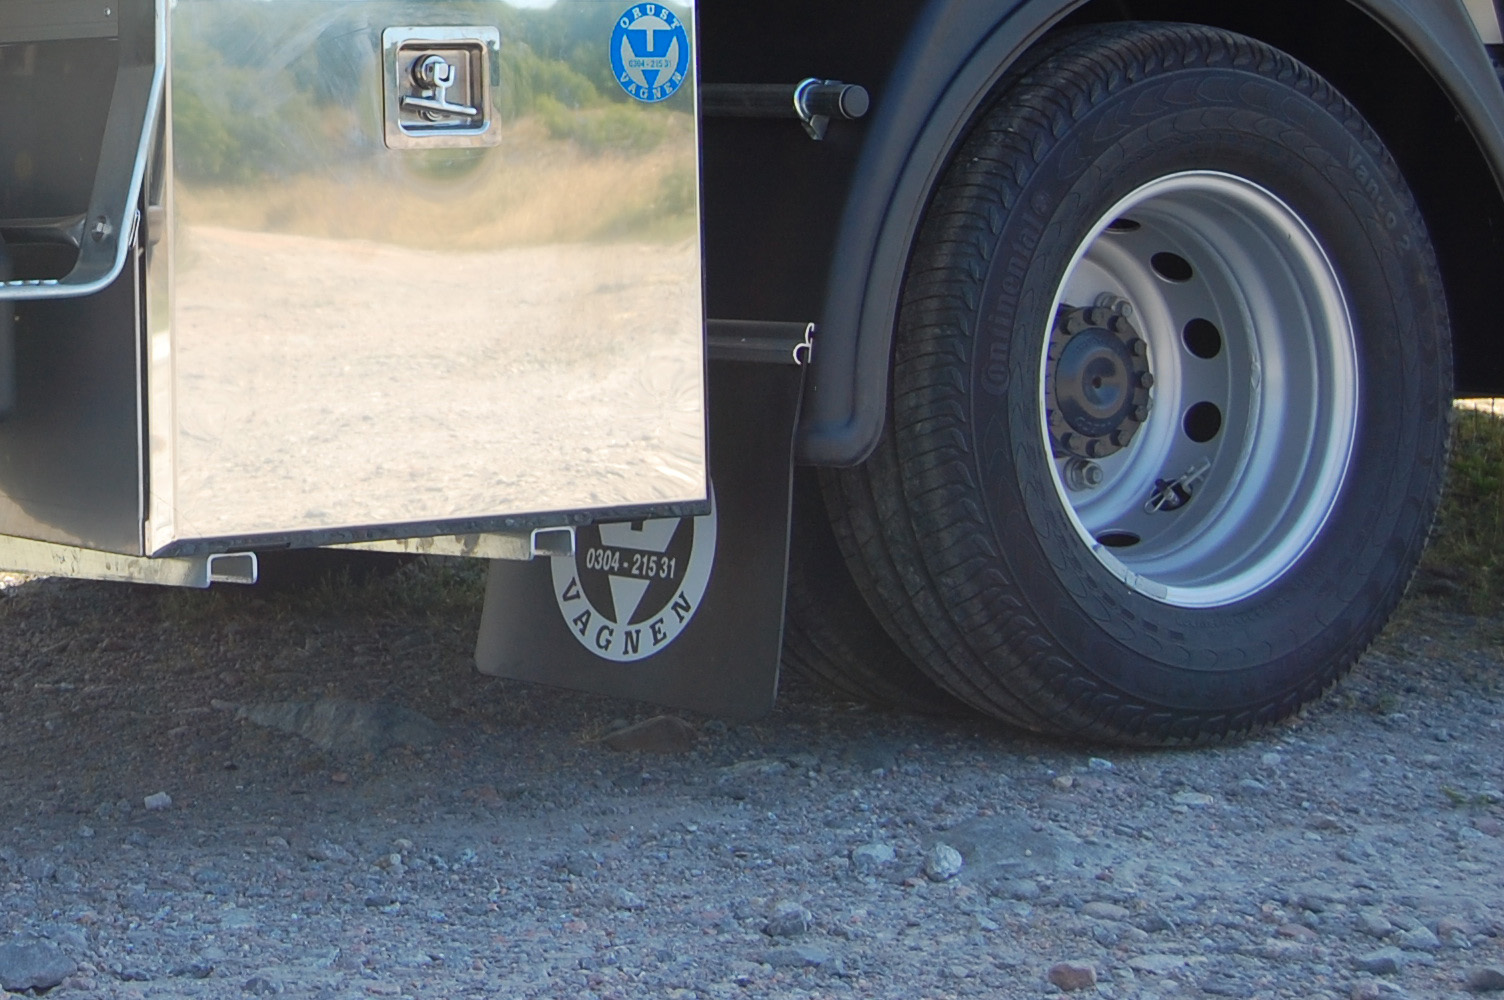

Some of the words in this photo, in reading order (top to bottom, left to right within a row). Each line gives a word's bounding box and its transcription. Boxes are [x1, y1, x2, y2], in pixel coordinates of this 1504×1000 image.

[620, 4, 681, 31] ORUST
[620, 71, 682, 99] VAGNEN
[1347, 145, 1396, 231] Vanco
[980, 213, 1045, 397] Continental
[586, 548, 620, 571] 0304
[562, 577, 692, 656] VAGNEN
